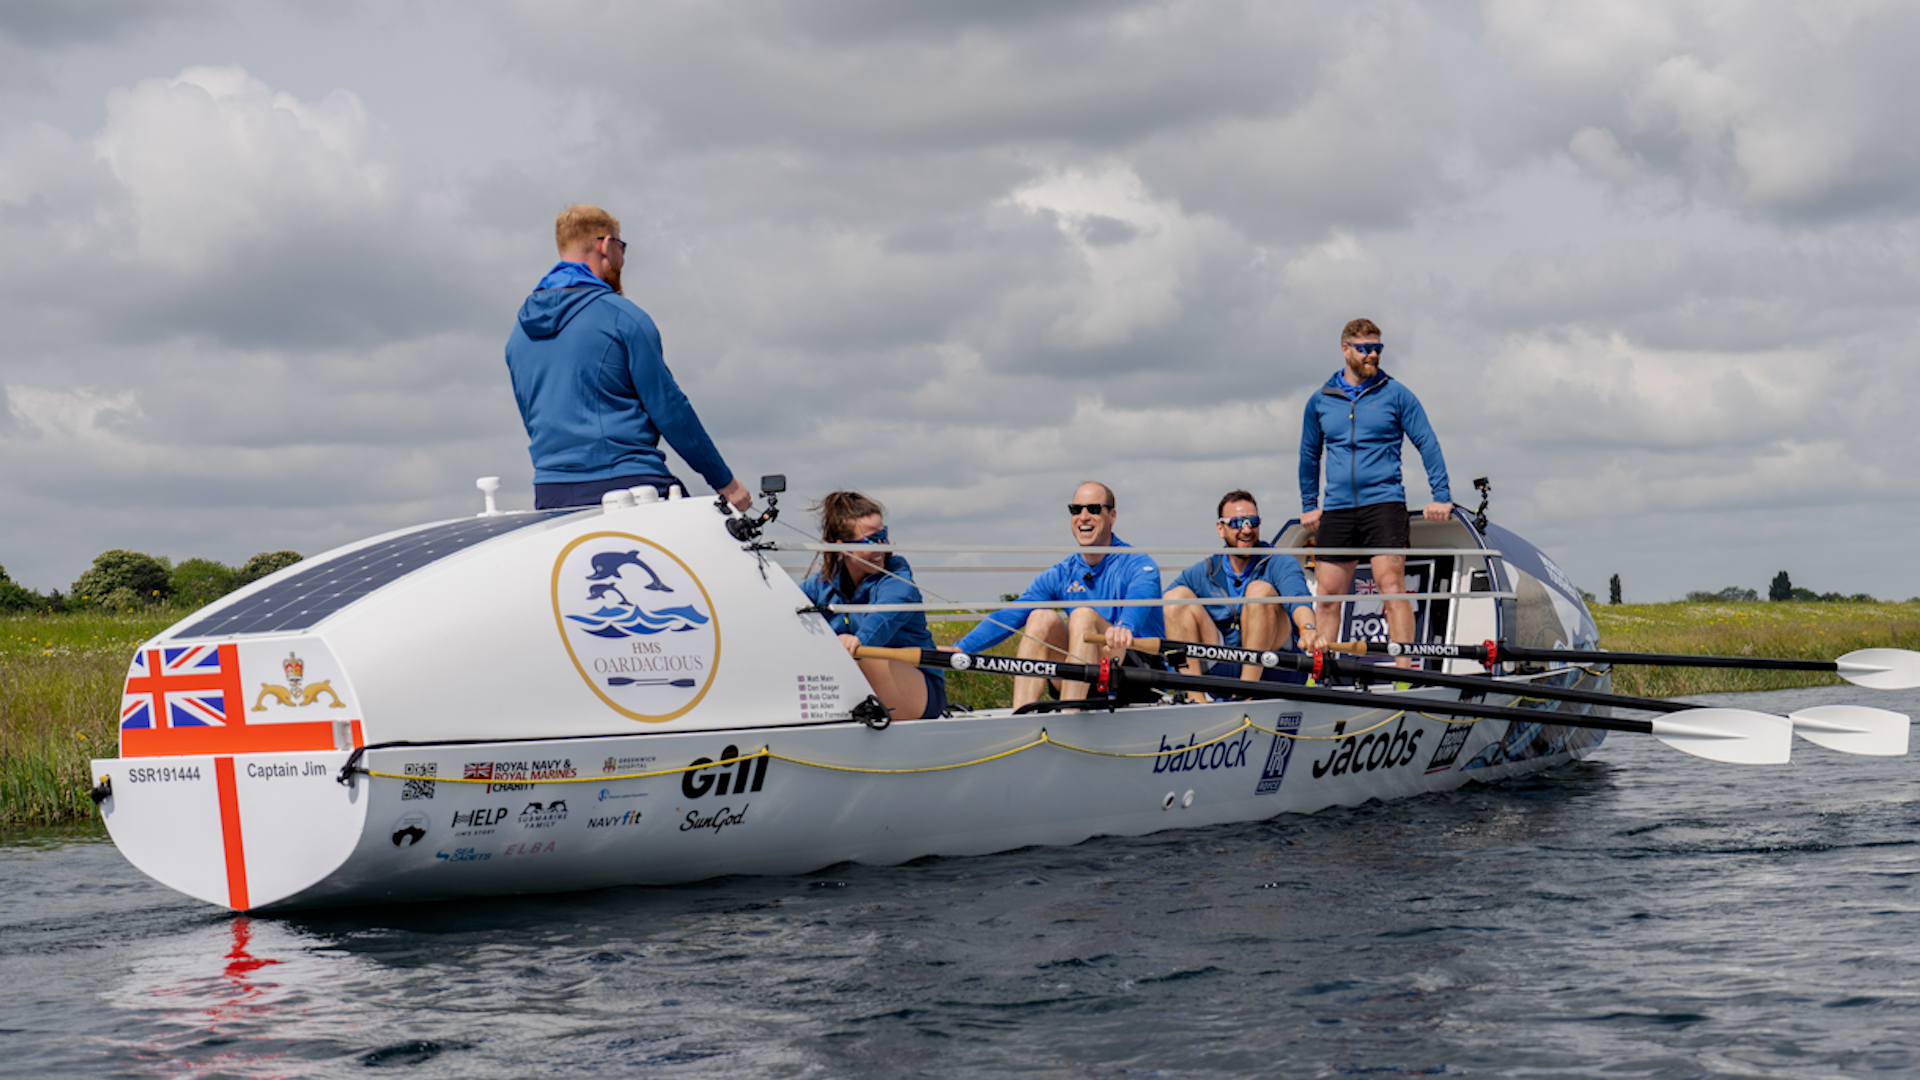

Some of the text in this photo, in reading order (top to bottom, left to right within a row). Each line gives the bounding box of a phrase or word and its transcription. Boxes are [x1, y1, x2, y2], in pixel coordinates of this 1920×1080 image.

[1350, 618, 1389, 636] ROY
[632, 642, 662, 654] HMS
[1186, 645, 1258, 664] RANNOCH
[1403, 644, 1459, 656] RANNOCH
[594, 655, 703, 673] OARDACIOUS
[975, 656, 1057, 675] RANNOCH
[1153, 730, 1253, 774] babcock
[1312, 716, 1424, 779] Jacobs
[129, 766, 201, 783] SSR191444
[247, 761, 327, 779] Captain Jim
[494, 768, 577, 781] ROYAL MARINES
[495, 758, 571, 773] ROYAL NAVY &
[682, 744, 769, 799] Gill
[451, 807, 508, 828] HELP
[504, 841, 556, 856] ELBA
